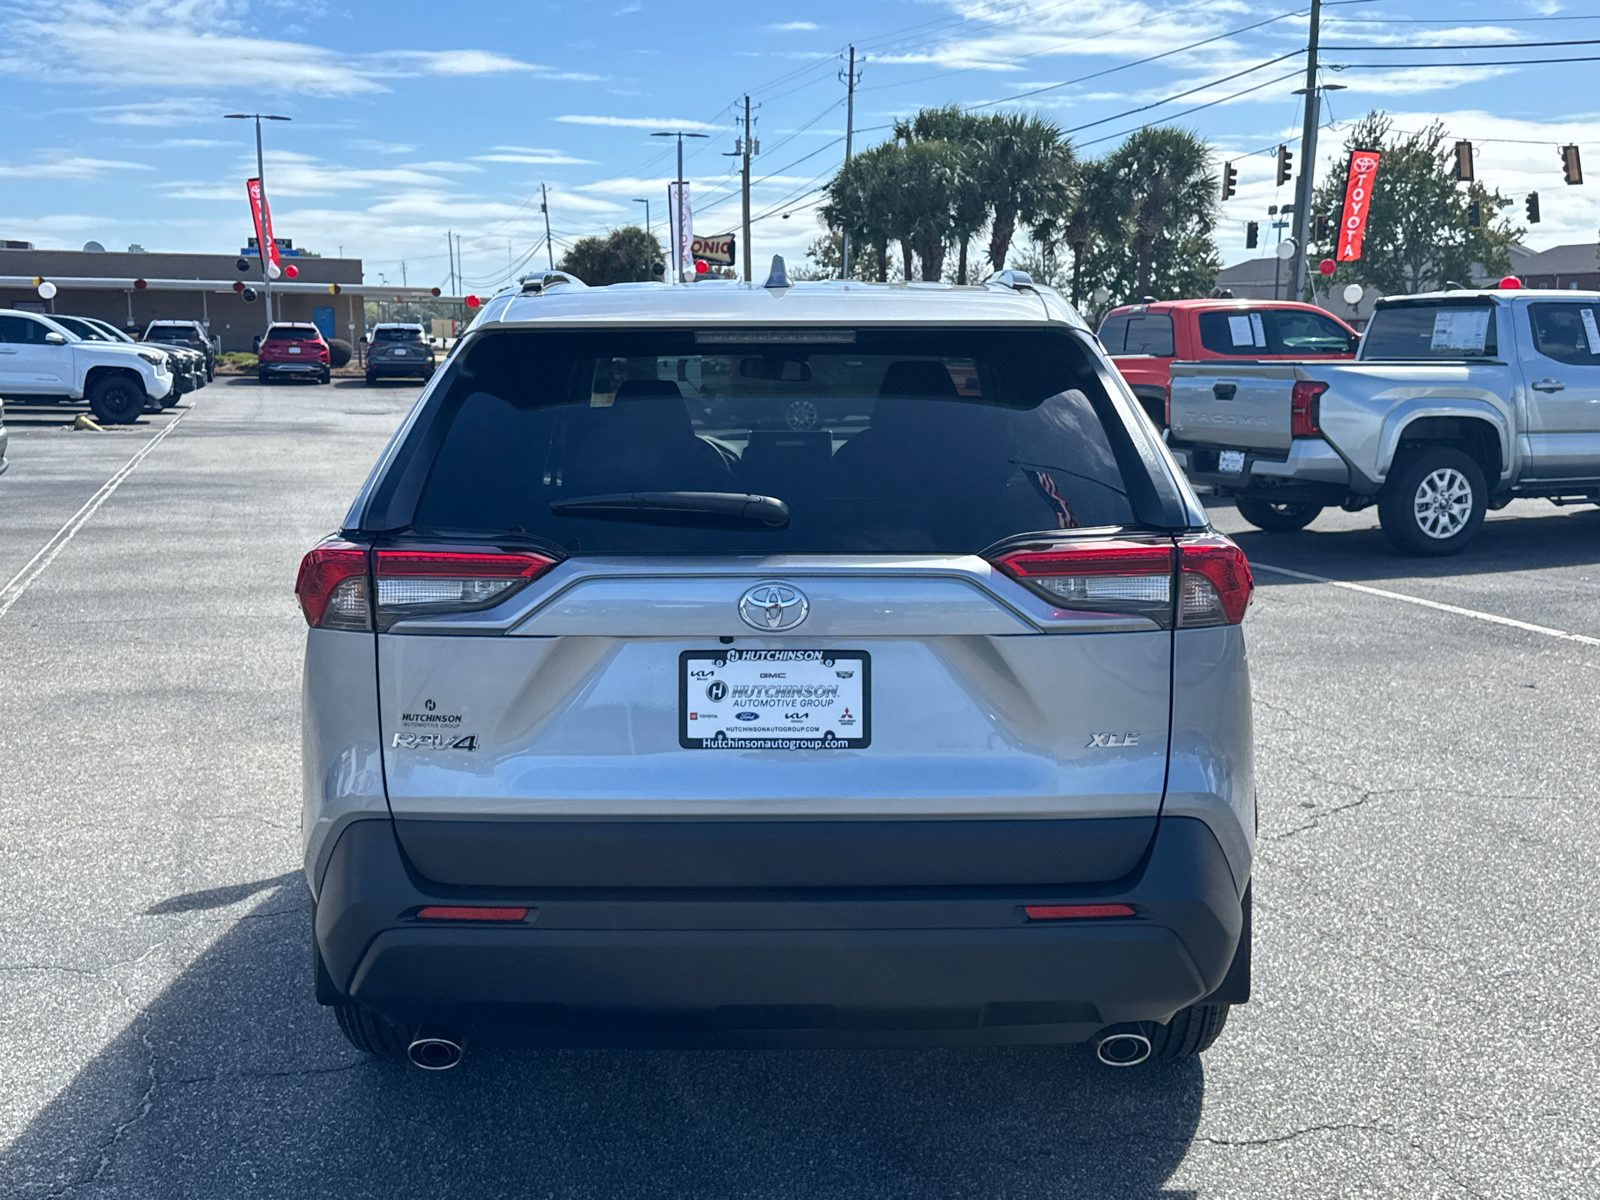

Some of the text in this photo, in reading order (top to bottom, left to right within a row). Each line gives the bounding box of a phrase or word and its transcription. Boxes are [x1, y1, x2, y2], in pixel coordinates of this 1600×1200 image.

[1344, 174, 1367, 257] TOYOTA
[690, 240, 730, 254] ONIC
[742, 650, 823, 661] HUTCHINSON
[731, 685, 839, 698] HUTCHINSON
[733, 699, 834, 707] AUTOMOTIVE GROUP
[402, 714, 462, 723] HUTCHINSON
[391, 732, 479, 752] RAV4
[702, 738, 849, 750] Hutchinsonautogroup.com
[1085, 731, 1141, 748] XLE
